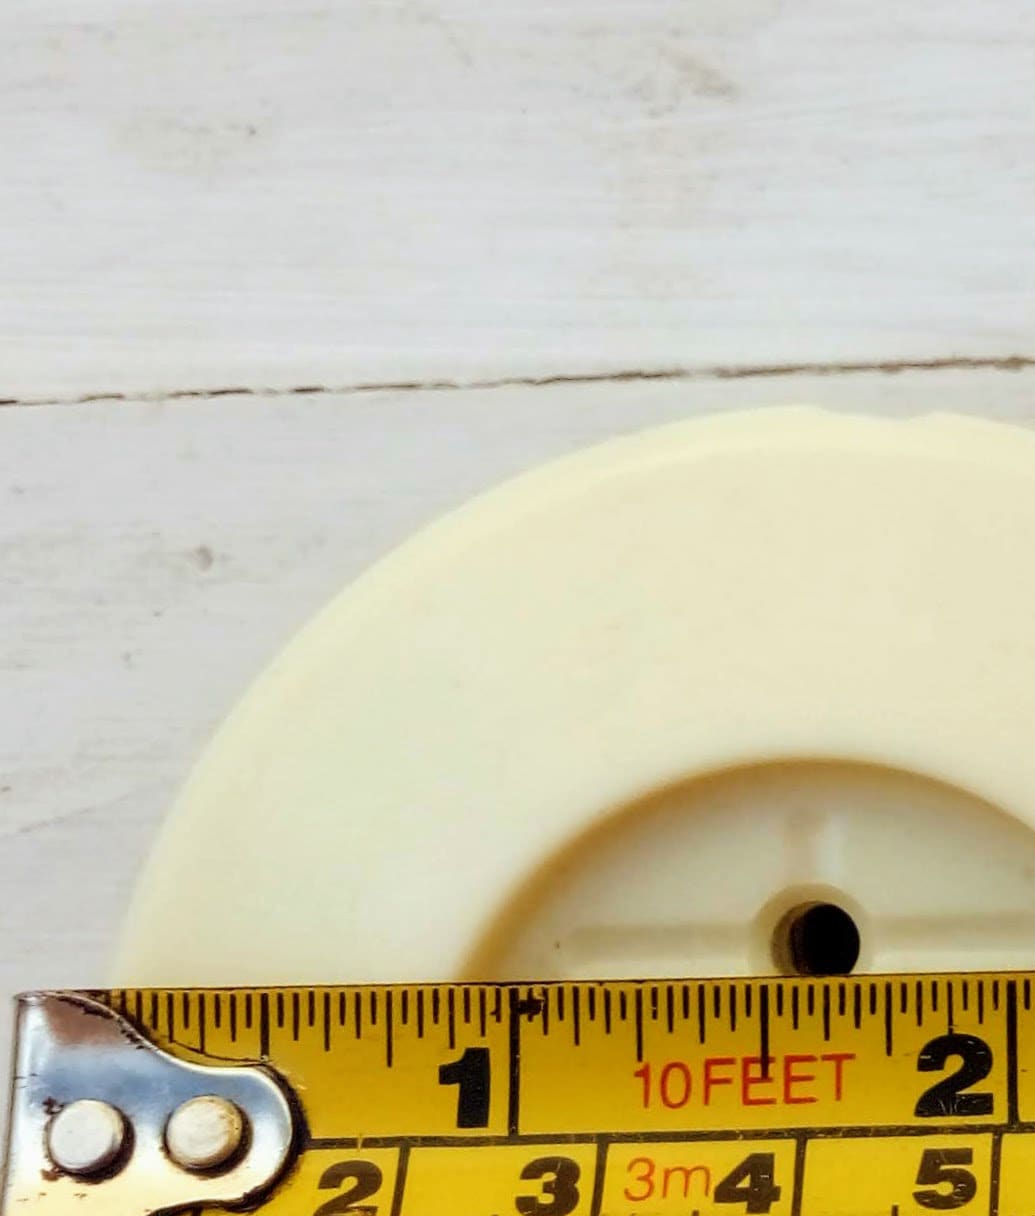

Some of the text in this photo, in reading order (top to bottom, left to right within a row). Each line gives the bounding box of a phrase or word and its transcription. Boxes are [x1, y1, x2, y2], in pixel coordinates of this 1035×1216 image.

[438, 1047, 490, 1128] 1
[634, 1052, 856, 1108] 10 FEET
[915, 1032, 994, 1118] 2
[624, 1157, 711, 1201] 3m
[714, 1153, 780, 1213] 4
[912, 1148, 977, 1210] 5
